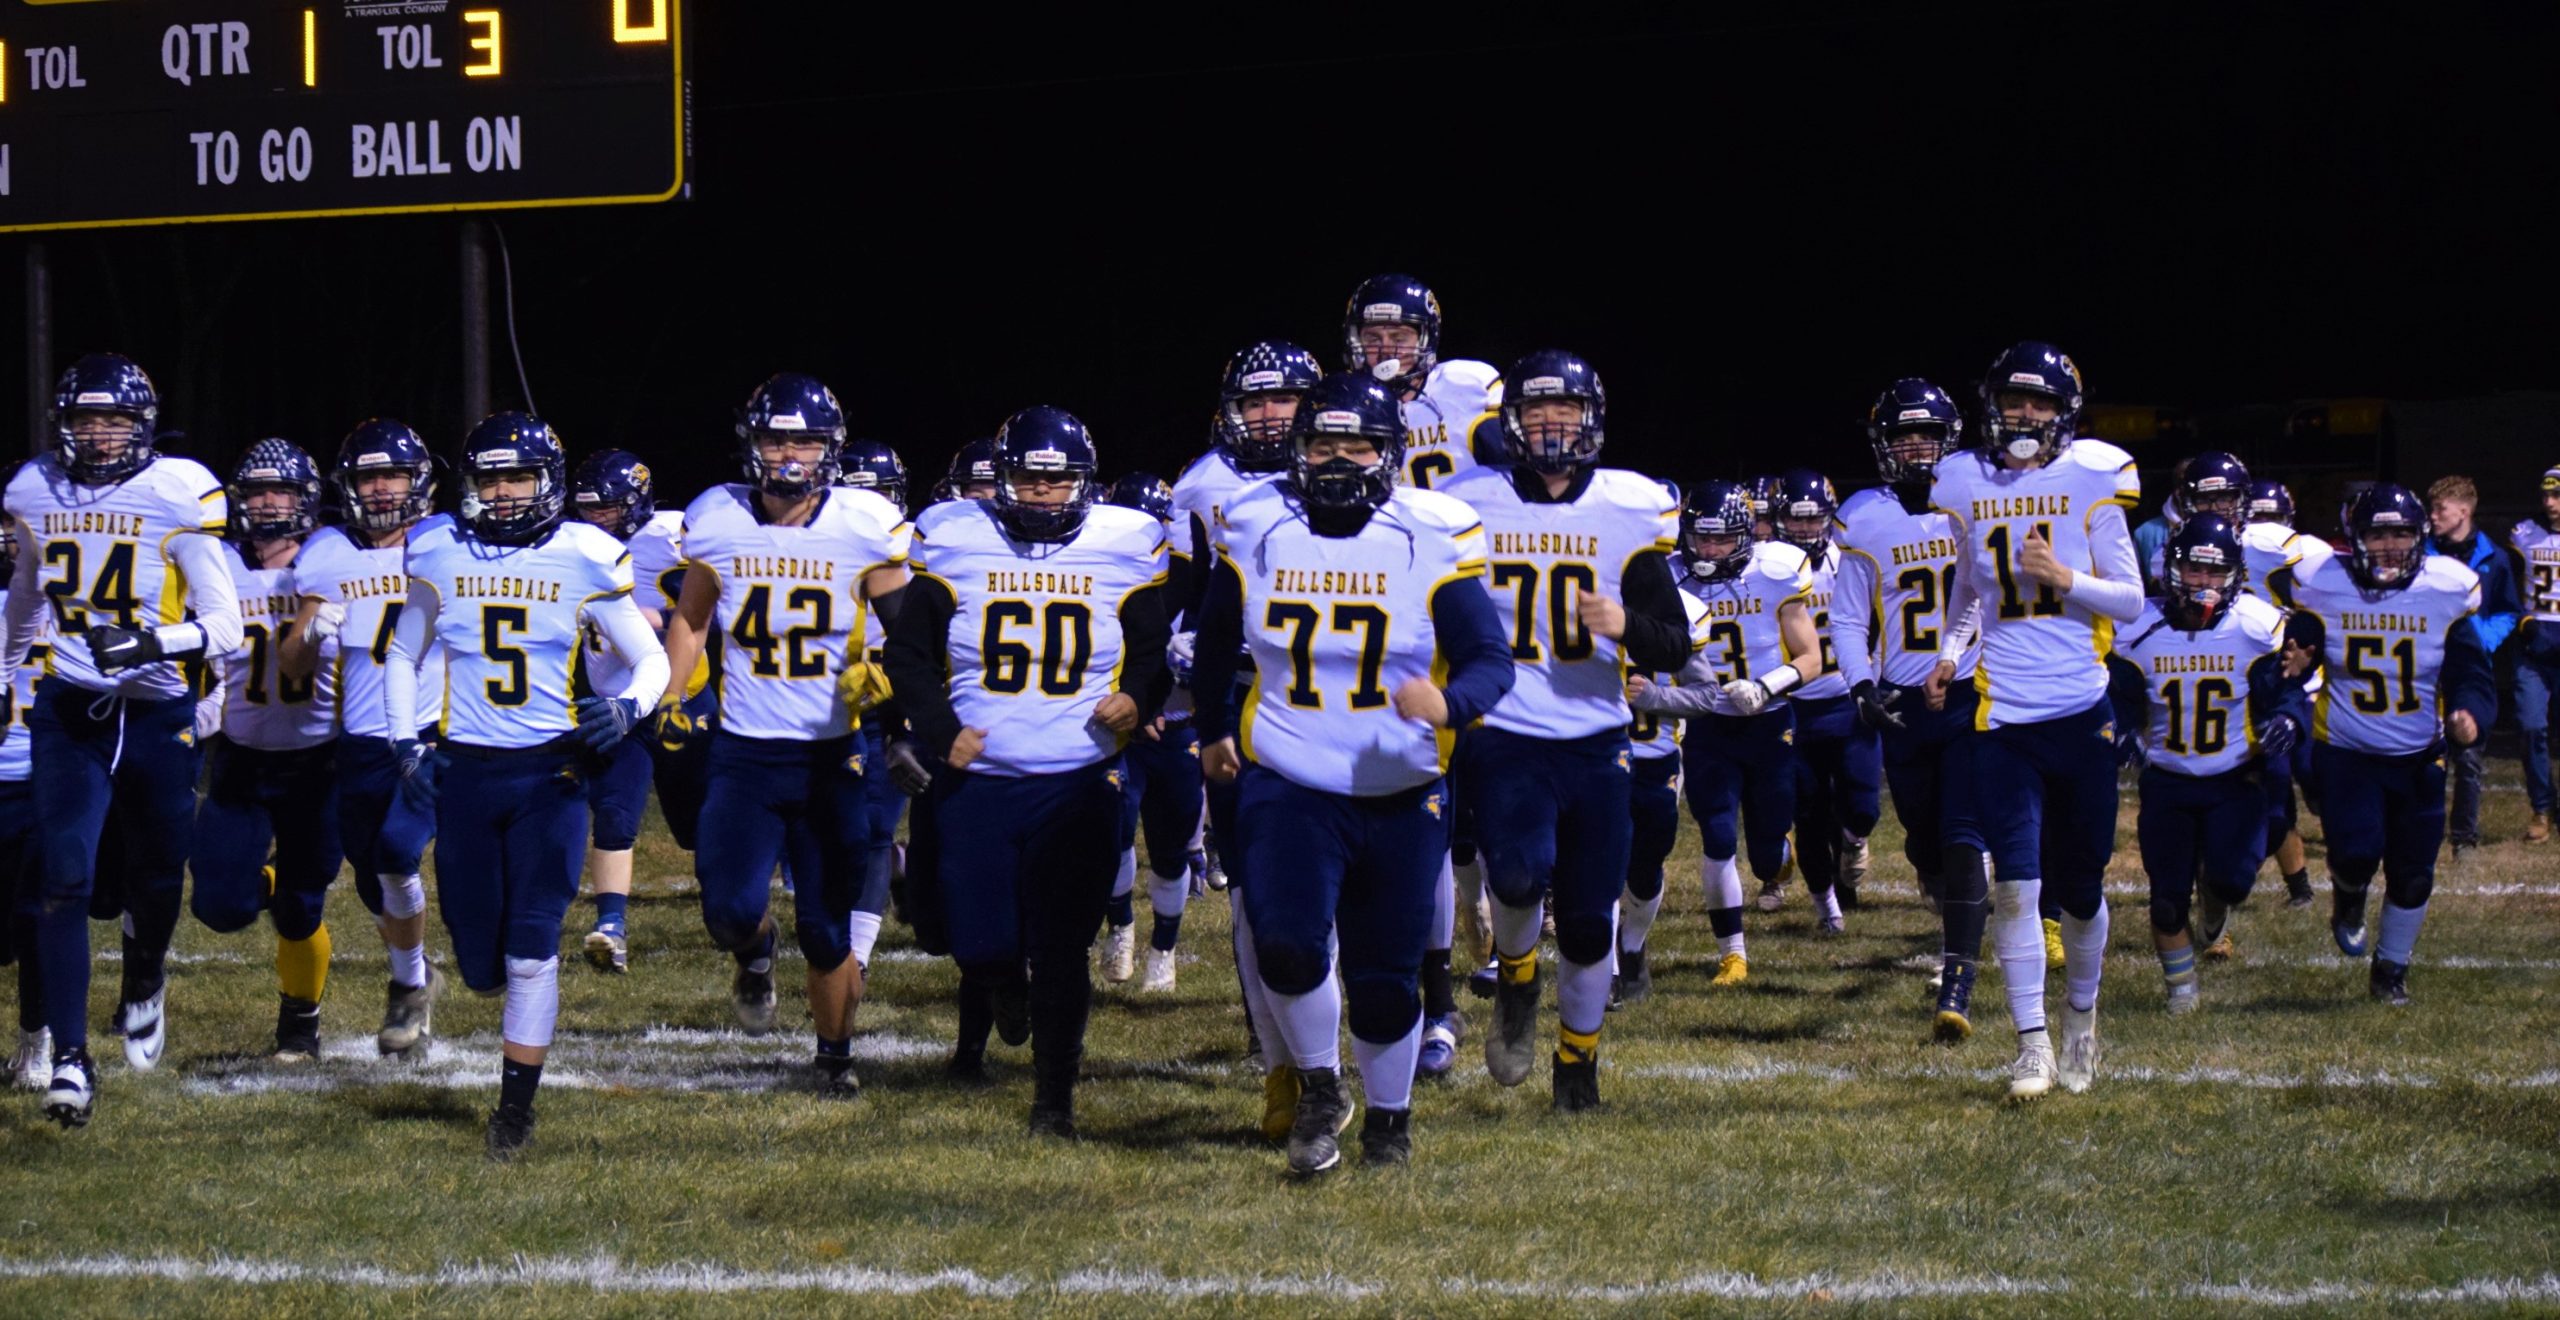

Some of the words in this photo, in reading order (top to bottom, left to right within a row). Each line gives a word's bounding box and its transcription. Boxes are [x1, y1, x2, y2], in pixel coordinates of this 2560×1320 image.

[345, 10, 353, 18] A
[404, 4, 447, 14] COMPANY
[162, 21, 250, 86] QTR
[304, 10, 315, 87] 1
[377, 24, 442, 70] TOL
[464, 11, 501, 76] 3
[25, 46, 87, 90] TOL
[190, 130, 239, 186] TO
[259, 126, 312, 183] GO
[352, 120, 451, 178] BALL
[466, 115, 521, 173] ON
[1034, 452, 1058, 461] Riddell
[44, 512, 144, 538] HILLSDALE
[1972, 495, 2070, 521] HILLSDALE
[1494, 532, 1598, 557] HILLSDALE
[1891, 538, 1957, 565] HILLSDA
[44, 538, 144, 637] 24
[340, 575, 411, 600] HILLSD
[455, 576, 560, 602] HILLSDALE
[733, 556, 833, 581] HILLSDALE
[987, 571, 1093, 595] HILLSDALE
[1274, 569, 1387, 597] HILLSDALE
[1491, 559, 1597, 664] 70
[1708, 598, 1762, 617] LSDALE
[2341, 612, 2427, 634] HILLSDALE
[731, 583, 832, 680] 42
[979, 597, 1093, 698] 60
[480, 603, 531, 710] 5
[1263, 598, 1392, 712] 77
[2154, 655, 2235, 674] HILLSDALE
[2345, 634, 2421, 716] 51
[2160, 674, 2234, 757] 16
